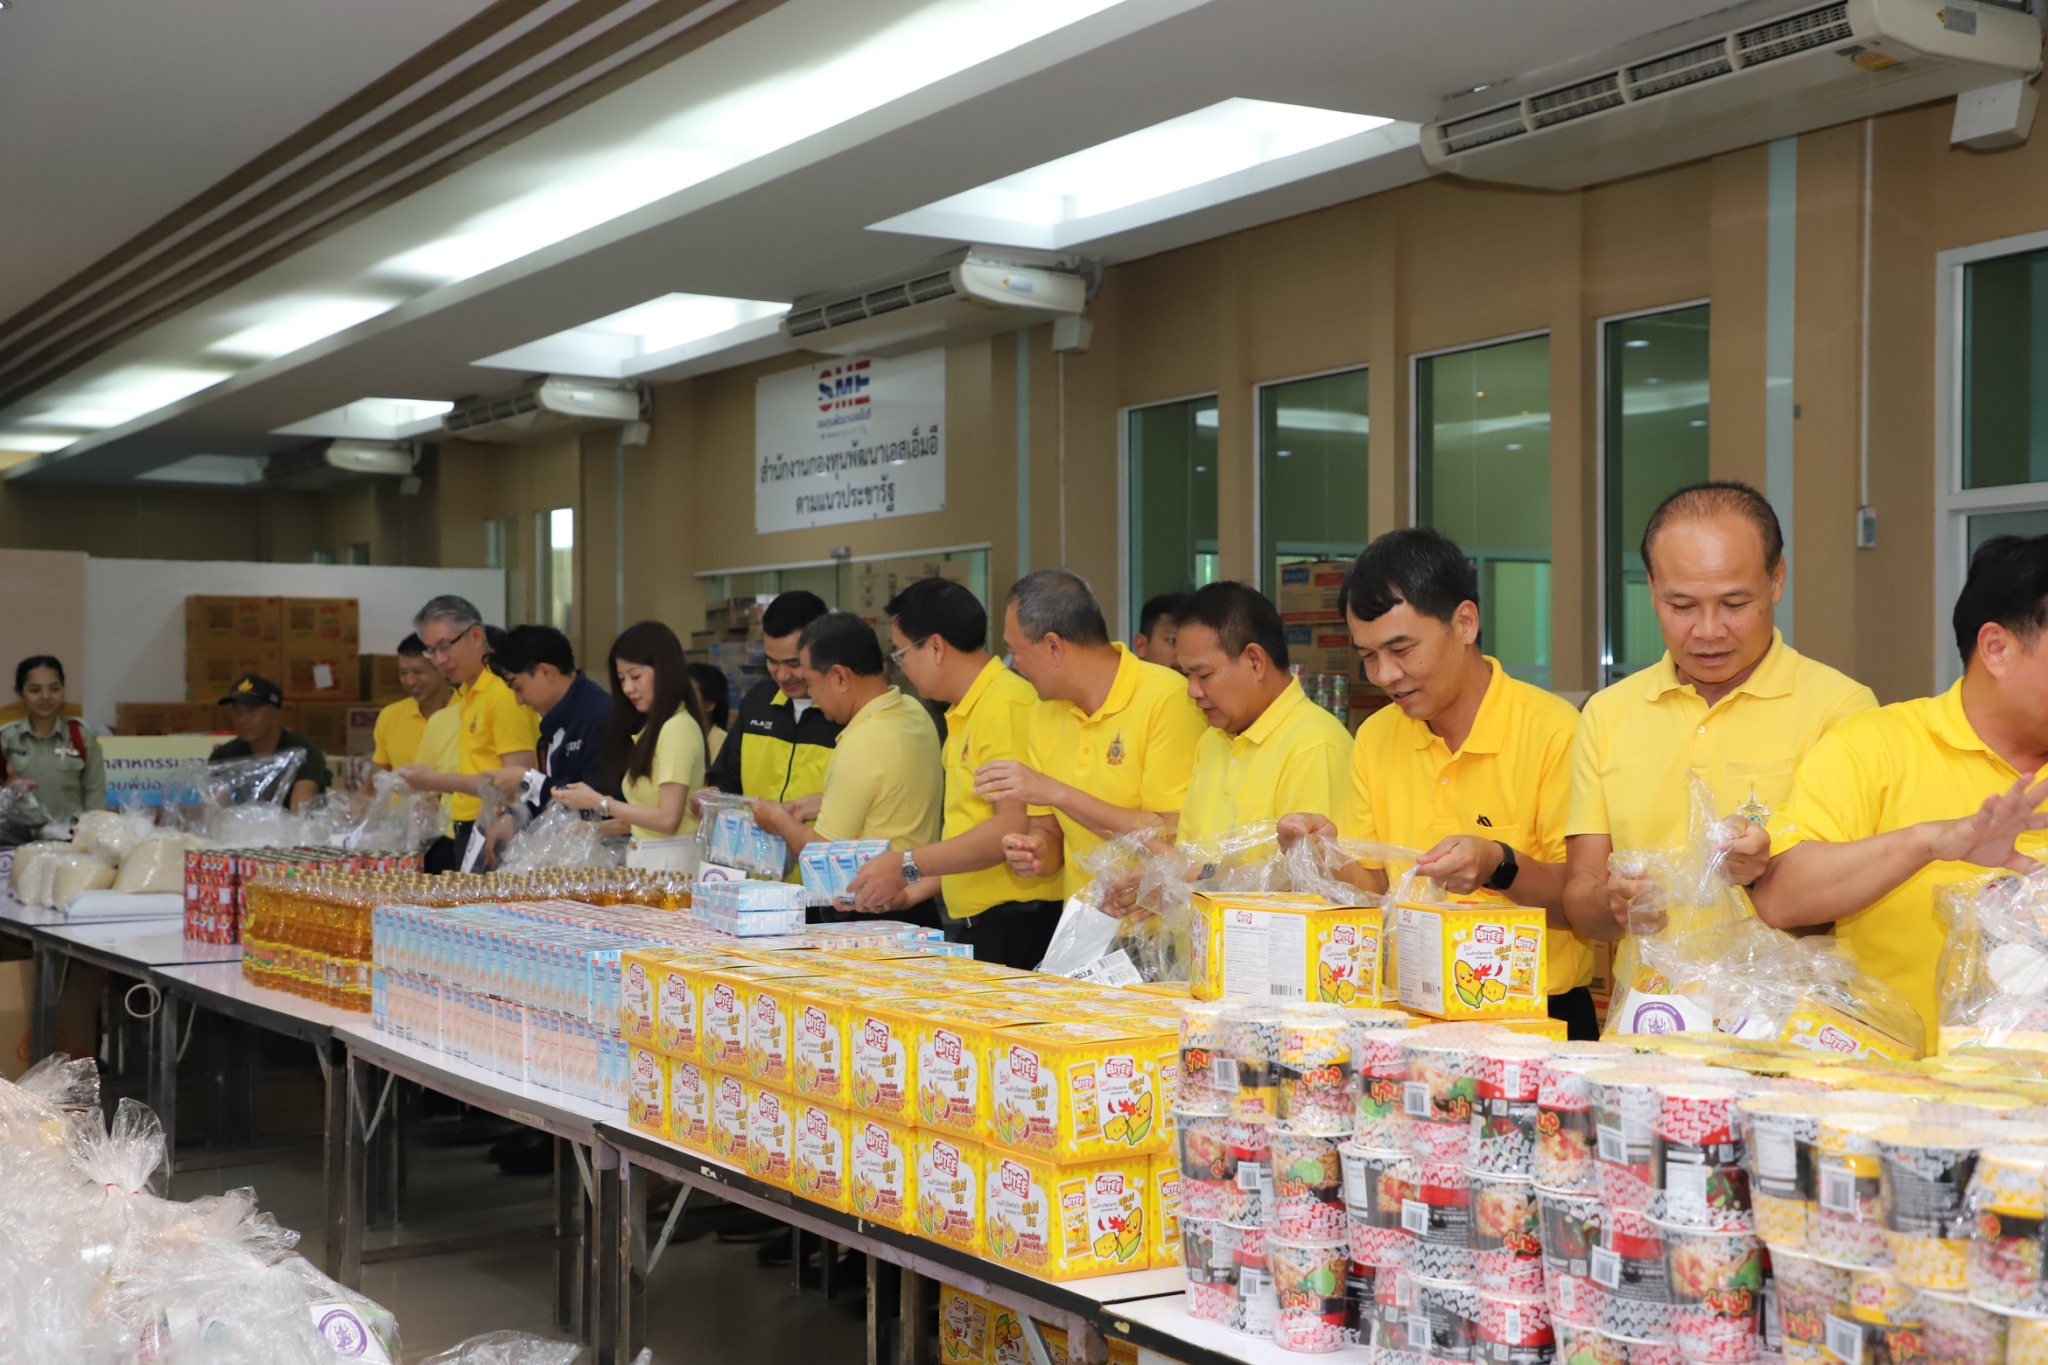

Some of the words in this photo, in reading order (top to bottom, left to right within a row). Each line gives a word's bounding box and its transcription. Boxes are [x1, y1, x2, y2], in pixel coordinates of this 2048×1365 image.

[818, 360, 871, 412] SME
[796, 474, 895, 512] ตามแนวประชารัฐ
[1334, 930, 1355, 942] BITEE
[1476, 929, 1503, 943] BITEE
[1516, 939, 1536, 950] BITEE
[805, 1012, 825, 1036] BITEE
[866, 1025, 888, 1047] BITEE
[1820, 1028, 1855, 1053] BITEE
[935, 1035, 960, 1061] BITEE
[1010, 1050, 1037, 1078] BITEE
[1106, 1063, 1132, 1075] BITEE
[1162, 1070, 1178, 1079] BITE
[1073, 1078, 1094, 1089] BITEE
[760, 1096, 778, 1119] BITEE
[807, 1113, 827, 1137] BITEE
[866, 1129, 888, 1153] BITEE
[933, 1146, 958, 1174] BITEE
[1001, 1166, 1028, 1193] BITEE
[1096, 1180, 1122, 1193] BITEE
[1064, 1196, 1083, 1207] BITEE
